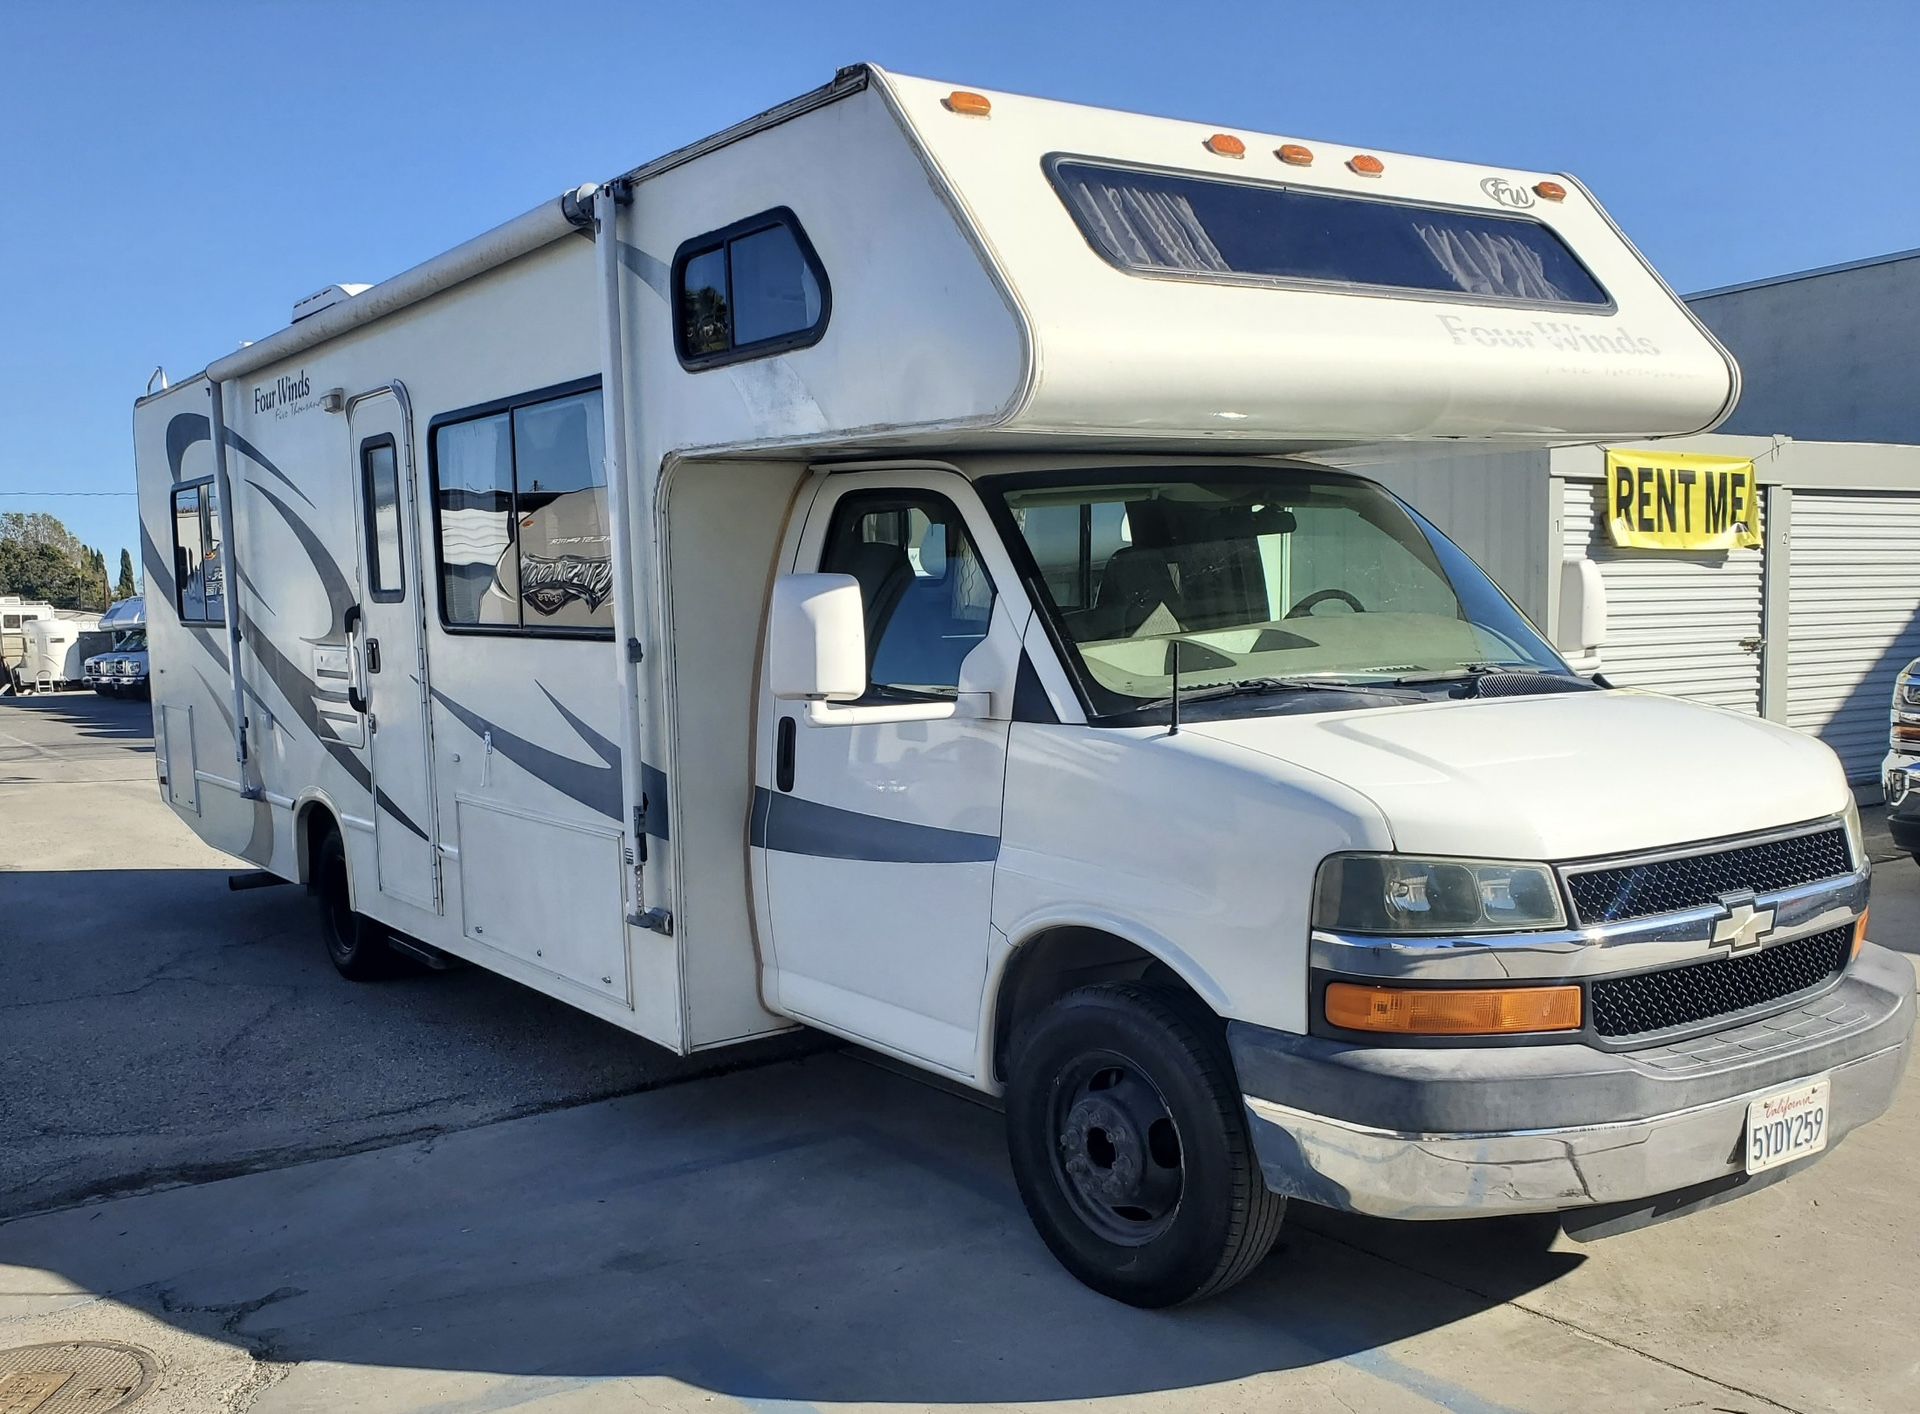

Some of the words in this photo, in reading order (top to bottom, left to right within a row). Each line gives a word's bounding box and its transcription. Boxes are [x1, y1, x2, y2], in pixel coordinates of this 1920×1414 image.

[1436, 314, 1534, 348] Four
[1532, 321, 1661, 355] Winds
[254, 387, 276, 414] Four
[277, 369, 310, 405] Winds
[1616, 466, 1696, 533] RENT
[1705, 472, 1748, 534] ME
[1782, 532, 1789, 545] 2
[1765, 1096, 1814, 1118] California
[1752, 1107, 1824, 1161] 5YDY259
